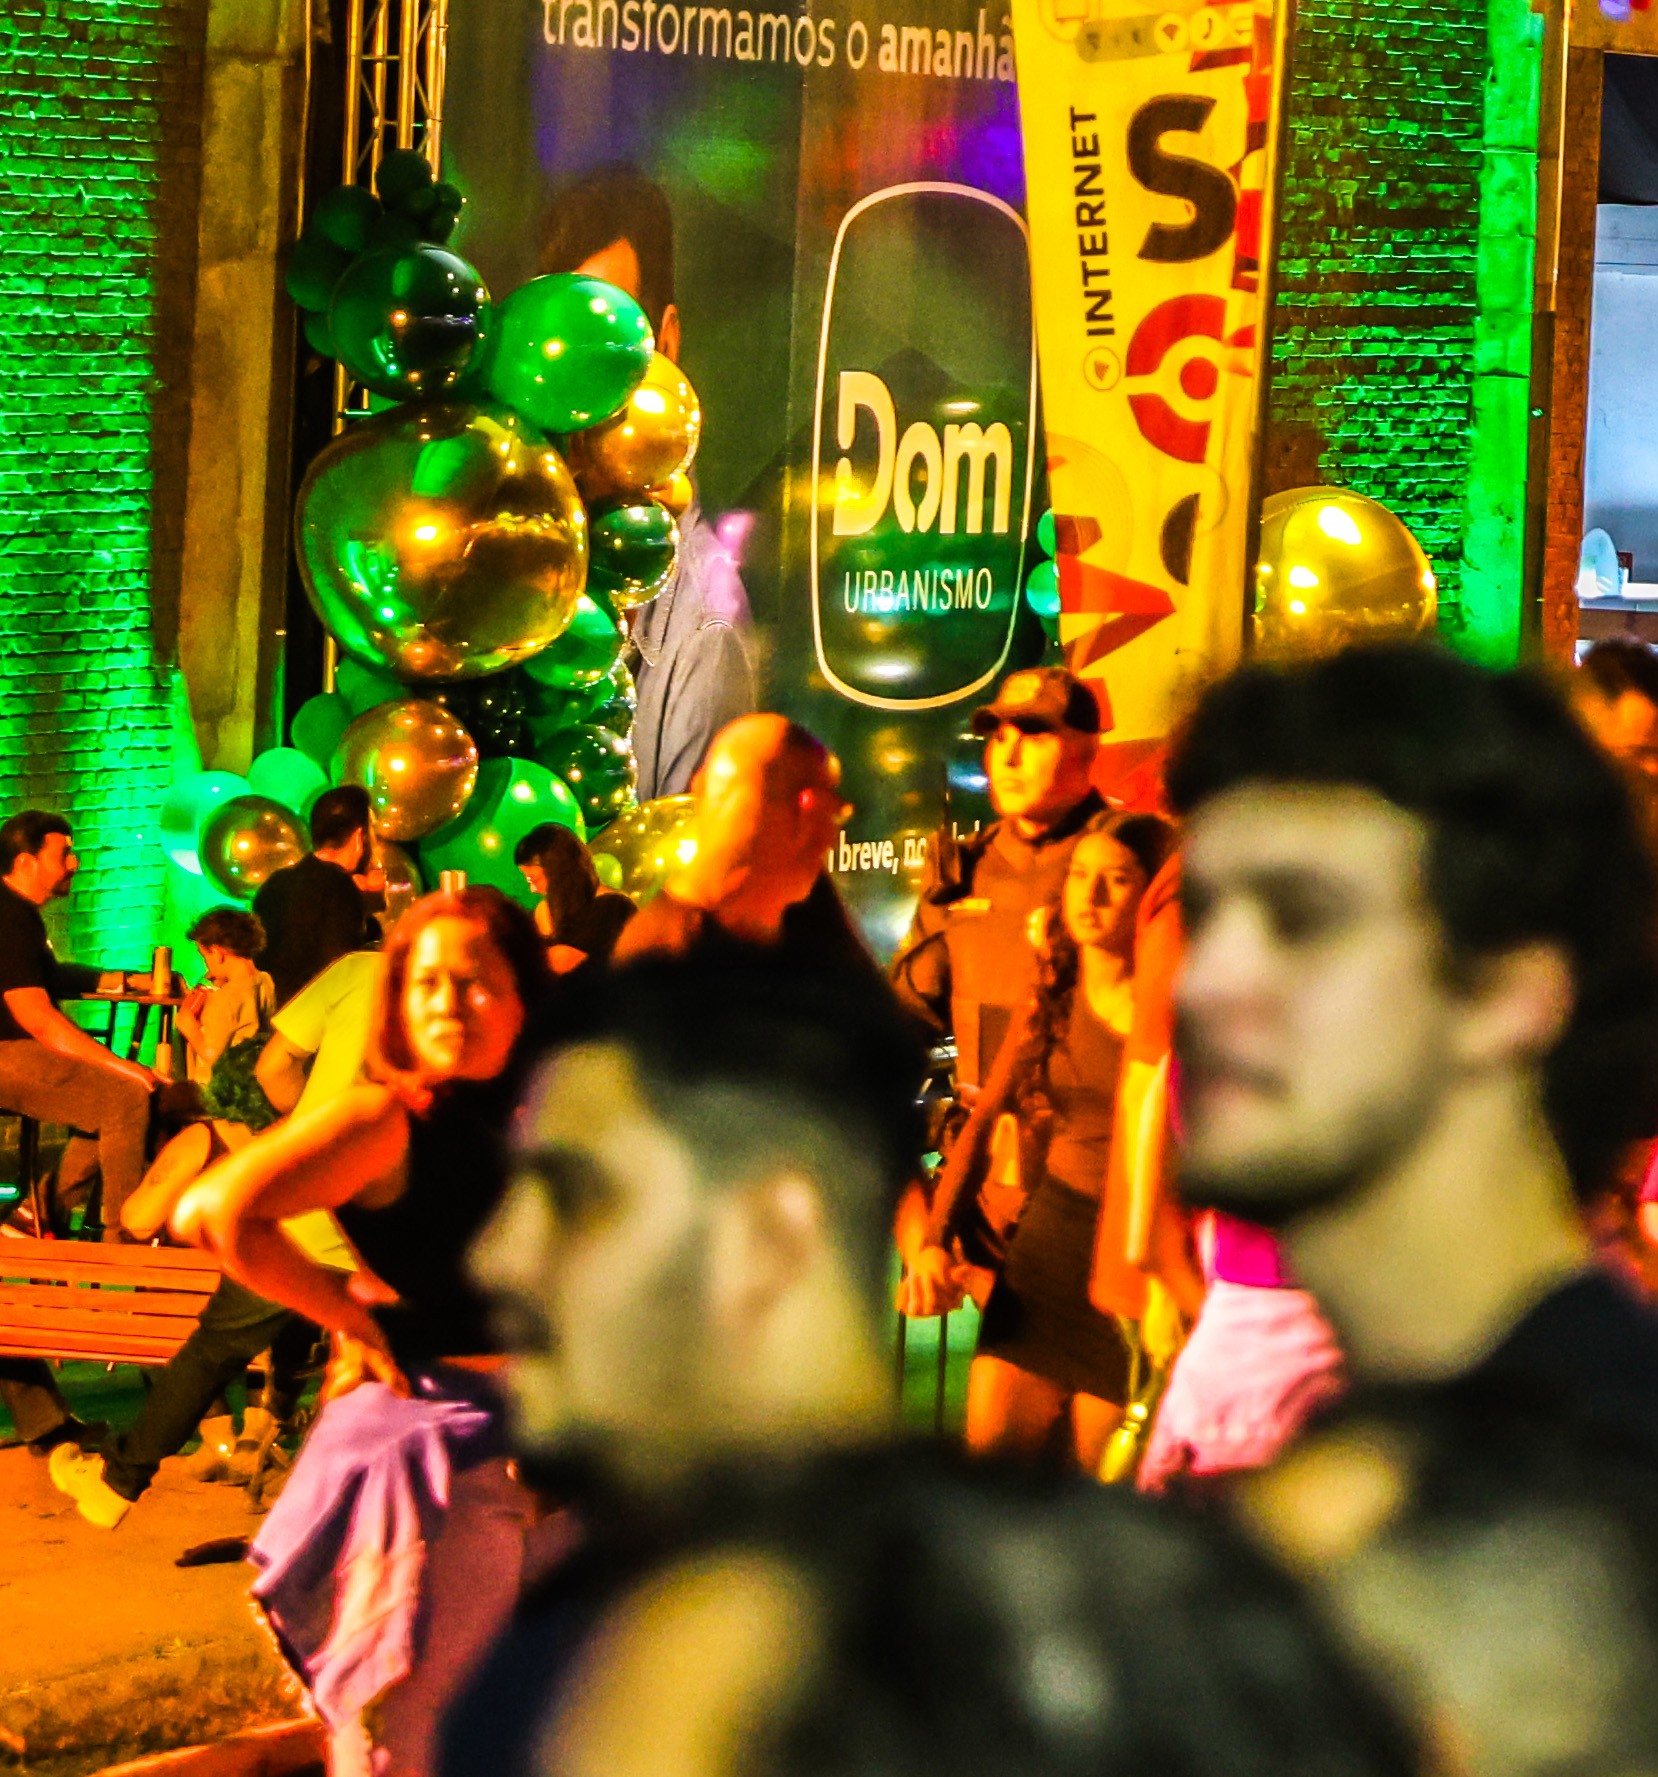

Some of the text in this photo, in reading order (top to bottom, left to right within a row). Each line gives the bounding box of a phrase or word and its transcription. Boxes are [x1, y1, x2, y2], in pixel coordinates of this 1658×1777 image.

[847, 21, 868, 69] o
[878, 8, 1015, 82] amanhã
[1070, 105, 1116, 337] INTERNET
[833, 371, 1013, 536] Dom
[844, 568, 993, 613] URBANISMO
[839, 830, 899, 875] breve,
